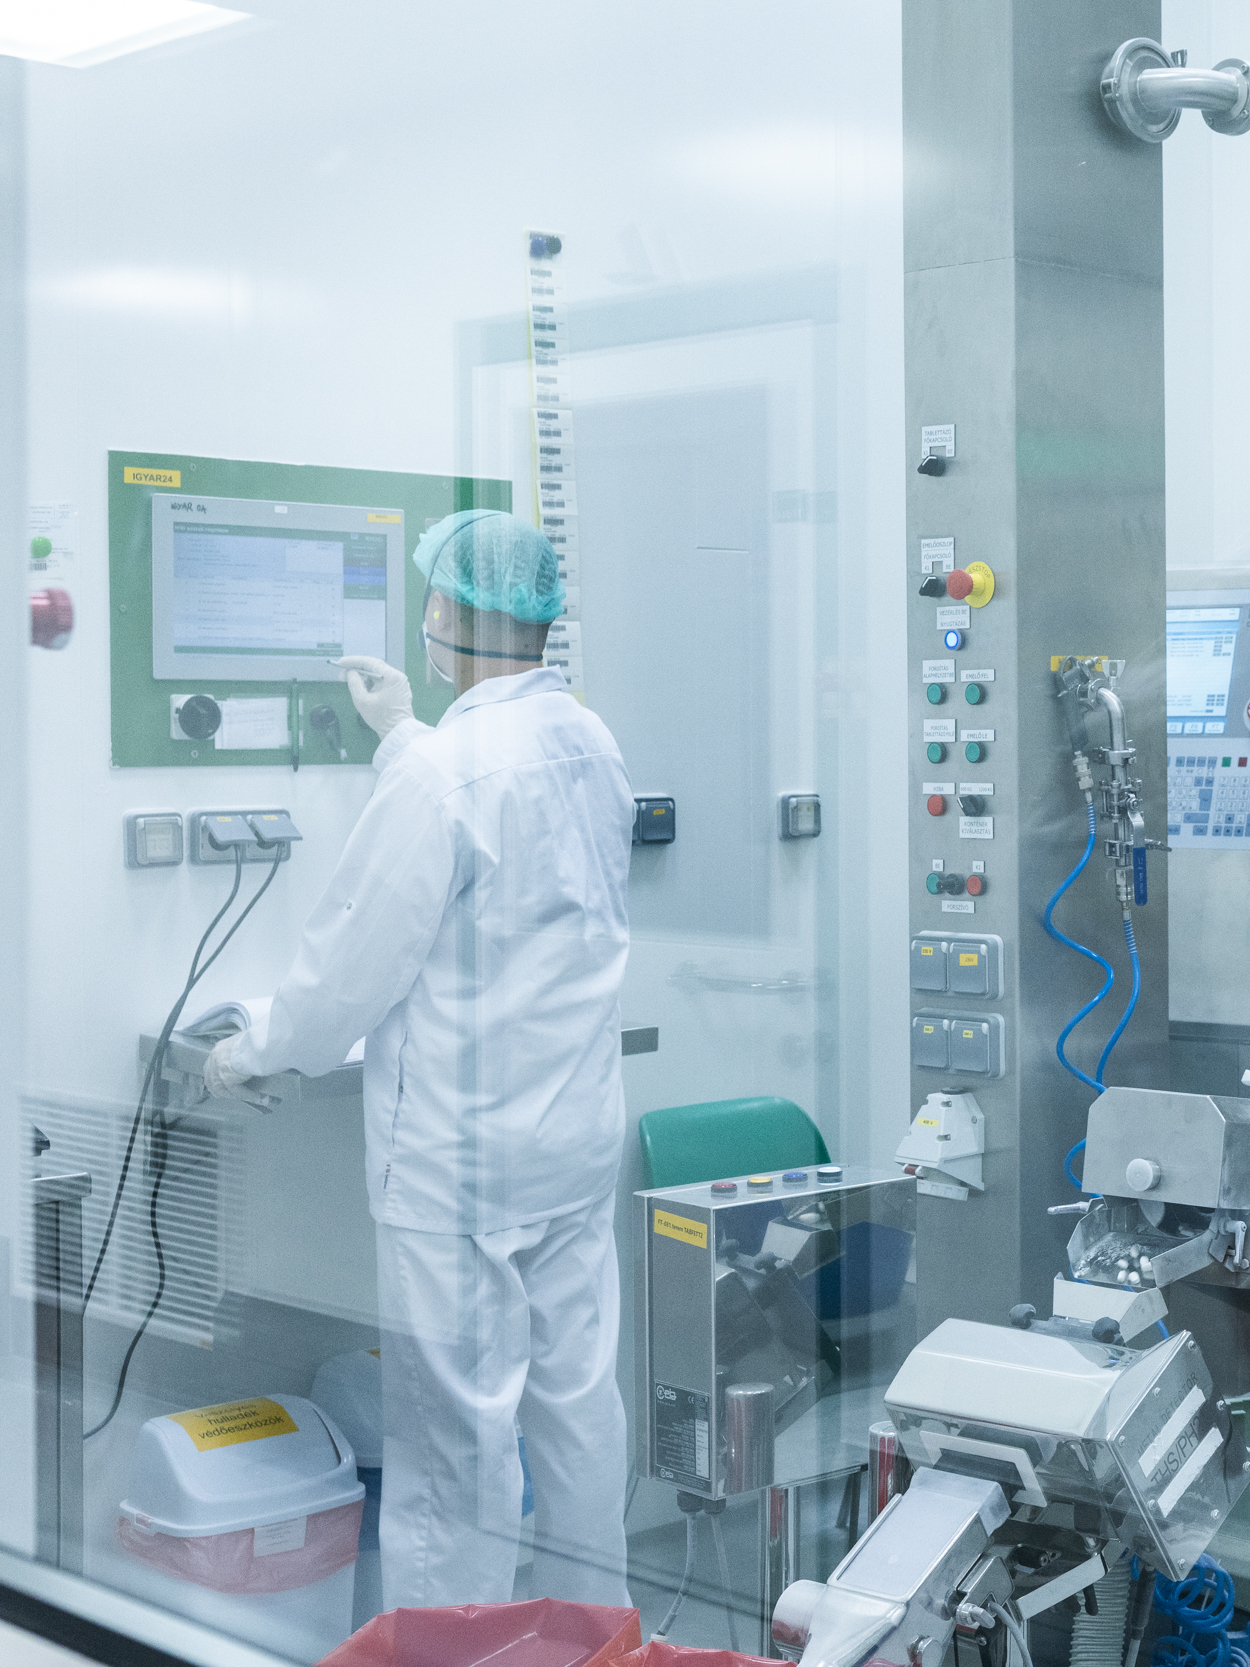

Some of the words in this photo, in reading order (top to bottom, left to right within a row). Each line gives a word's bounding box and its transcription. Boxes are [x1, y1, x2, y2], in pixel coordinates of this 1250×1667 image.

[132, 472, 173, 484] IGYAR24
[946, 902, 969, 911] PORSZÍVÓ
[207, 1409, 260, 1426] hulladék
[198, 1415, 285, 1440] védőeszközök
